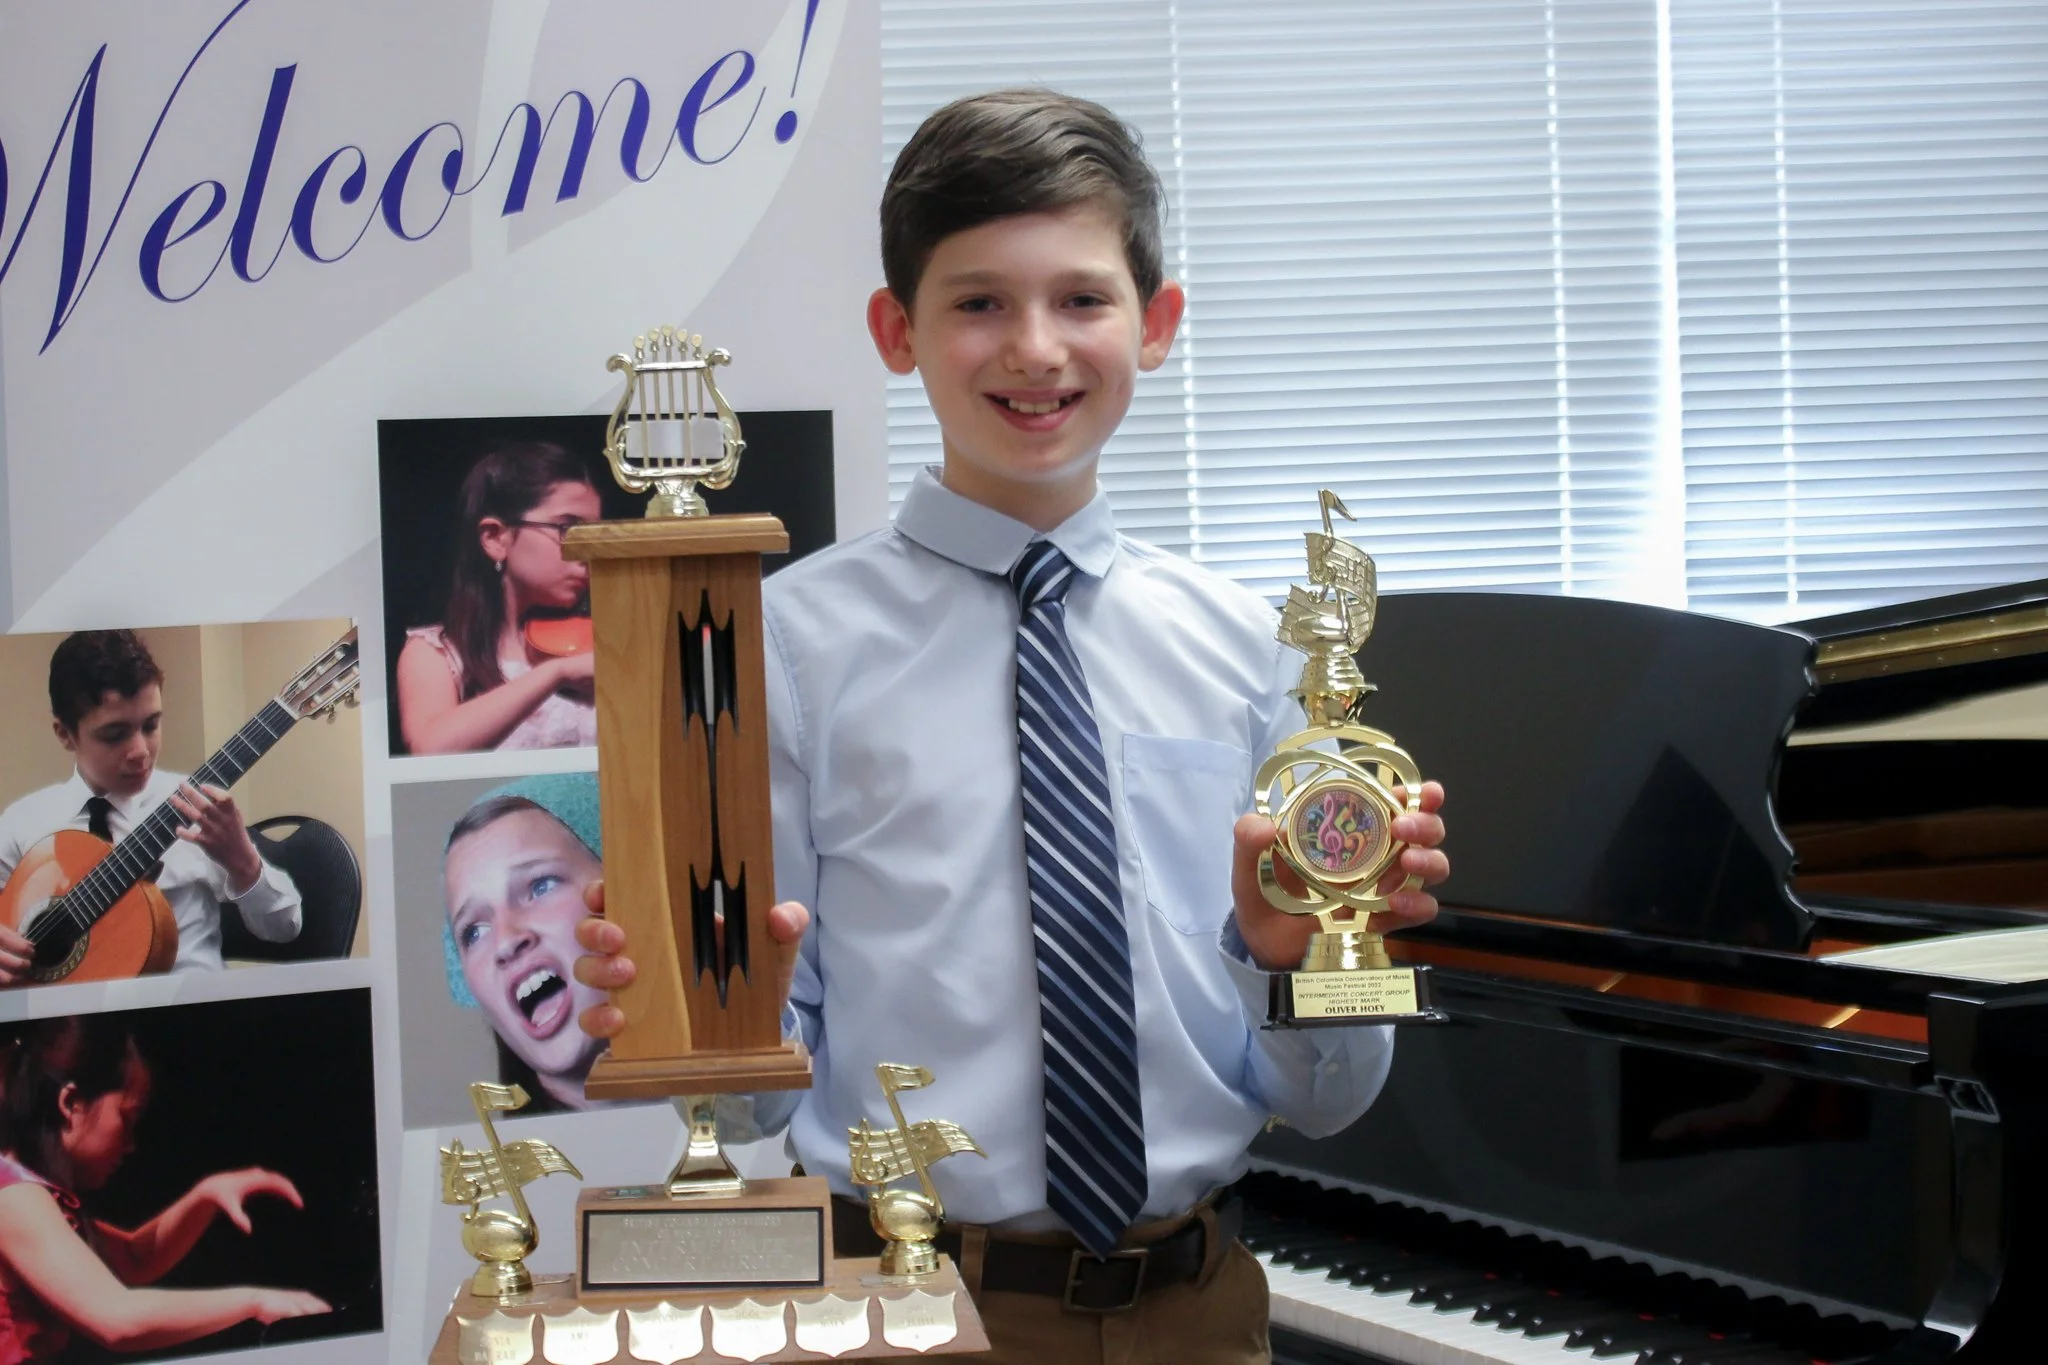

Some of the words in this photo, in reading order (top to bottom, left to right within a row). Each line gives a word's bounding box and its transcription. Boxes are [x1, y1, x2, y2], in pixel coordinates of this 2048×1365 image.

[0, 0, 822, 356] Welcome!
[1325, 1005, 1357, 1014] OLIVER
[1361, 1004, 1385, 1012] HOEY
